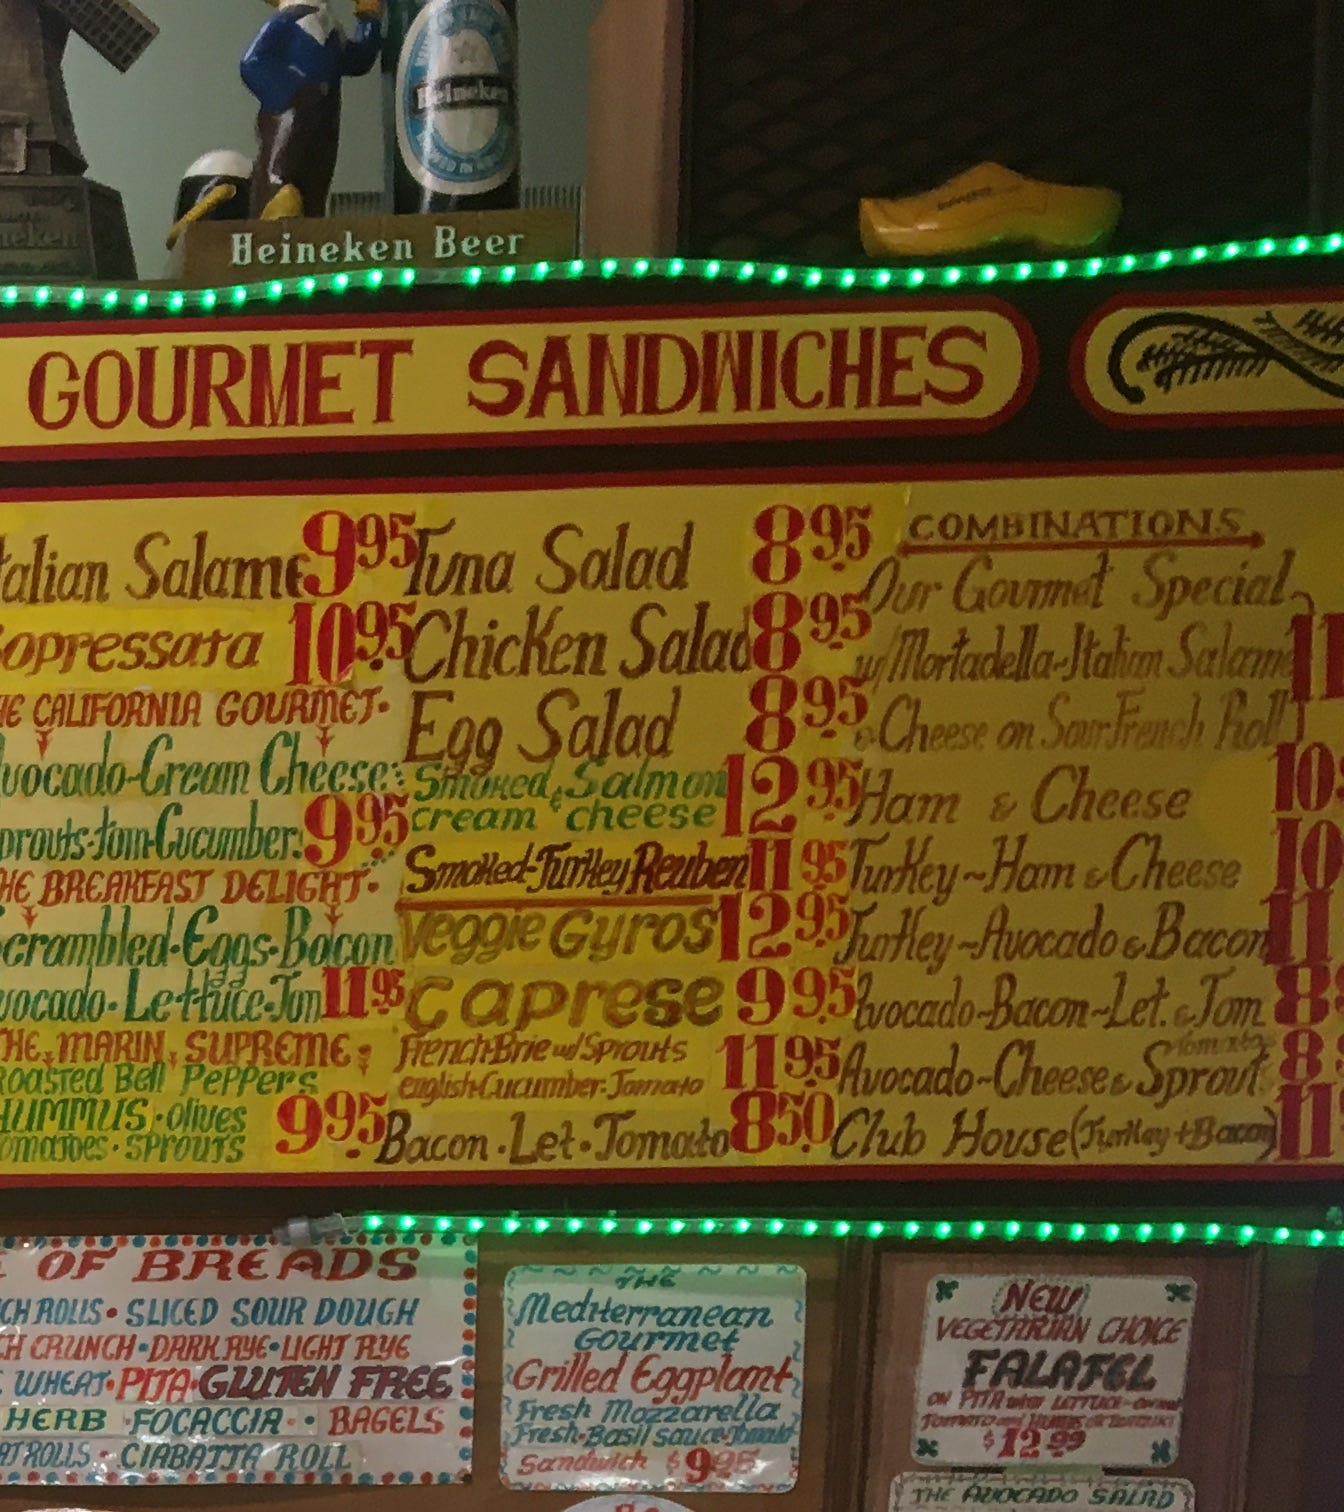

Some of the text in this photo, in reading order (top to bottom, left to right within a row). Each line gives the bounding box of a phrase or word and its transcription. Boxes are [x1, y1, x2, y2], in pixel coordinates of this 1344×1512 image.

[230, 225, 524, 267] Heineken Beer
[26, 338, 414, 432] GOURMET
[467, 325, 989, 420] SANDWICHES
[907, 507, 1242, 541] COMBINATIONS
[402, 516, 697, 598] Tuna Salad
[1130, 548, 1298, 622] Special
[402, 600, 752, 684] Chicken Salad
[30, 687, 204, 730] CALIFORNIA
[402, 685, 684, 782] Egg Salad
[848, 763, 1196, 827] Ham Cheese
[410, 798, 720, 835] cream cheese
[36, 866, 216, 909] BREAKFAST
[217, 866, 372, 906] DELIGHT
[550, 902, 717, 967] Gyros
[408, 974, 725, 1036] Caprese
[56, 1027, 354, 1068] MARIN SUPREME
[374, 1106, 734, 1168] Bacon Tomato
[832, 1104, 1073, 1160] Club House
[38, 1247, 140, 1282] OF
[132, 1246, 422, 1283] BREADS
[35, 1297, 106, 1326] ROLLS
[125, 1297, 219, 1328] SLICED
[230, 1297, 309, 1328] SOUR
[311, 1297, 421, 1328] DOUGH
[1000, 1279, 1086, 1313] NEW
[28, 1333, 140, 1362] CRUNCH
[150, 1334, 228, 1362] DARK
[230, 1334, 269, 1362] RYE
[280, 1334, 353, 1362] LIGHT
[354, 1334, 413, 1362] RYE
[936, 1315, 1189, 1347] VEGETARIAN CHOICE
[13, 1368, 111, 1397] WHEAT
[115, 1366, 194, 1403] PITA
[198, 1364, 343, 1401] GLUTEN
[346, 1363, 455, 1401] FREE
[514, 1352, 795, 1406] Grilled Eggplant
[962, 1348, 1159, 1393] FALAFEL
[2, 1406, 109, 1433] HERB
[128, 1405, 285, 1437] FOCACCIA
[326, 1405, 446, 1437] BAGELS
[516, 1394, 782, 1425] Fresh Mozzarella
[118, 1440, 268, 1473] CIABATTA
[269, 1440, 355, 1473] ROLL
[960, 1482, 1177, 1511] AVOCADO SALAD
